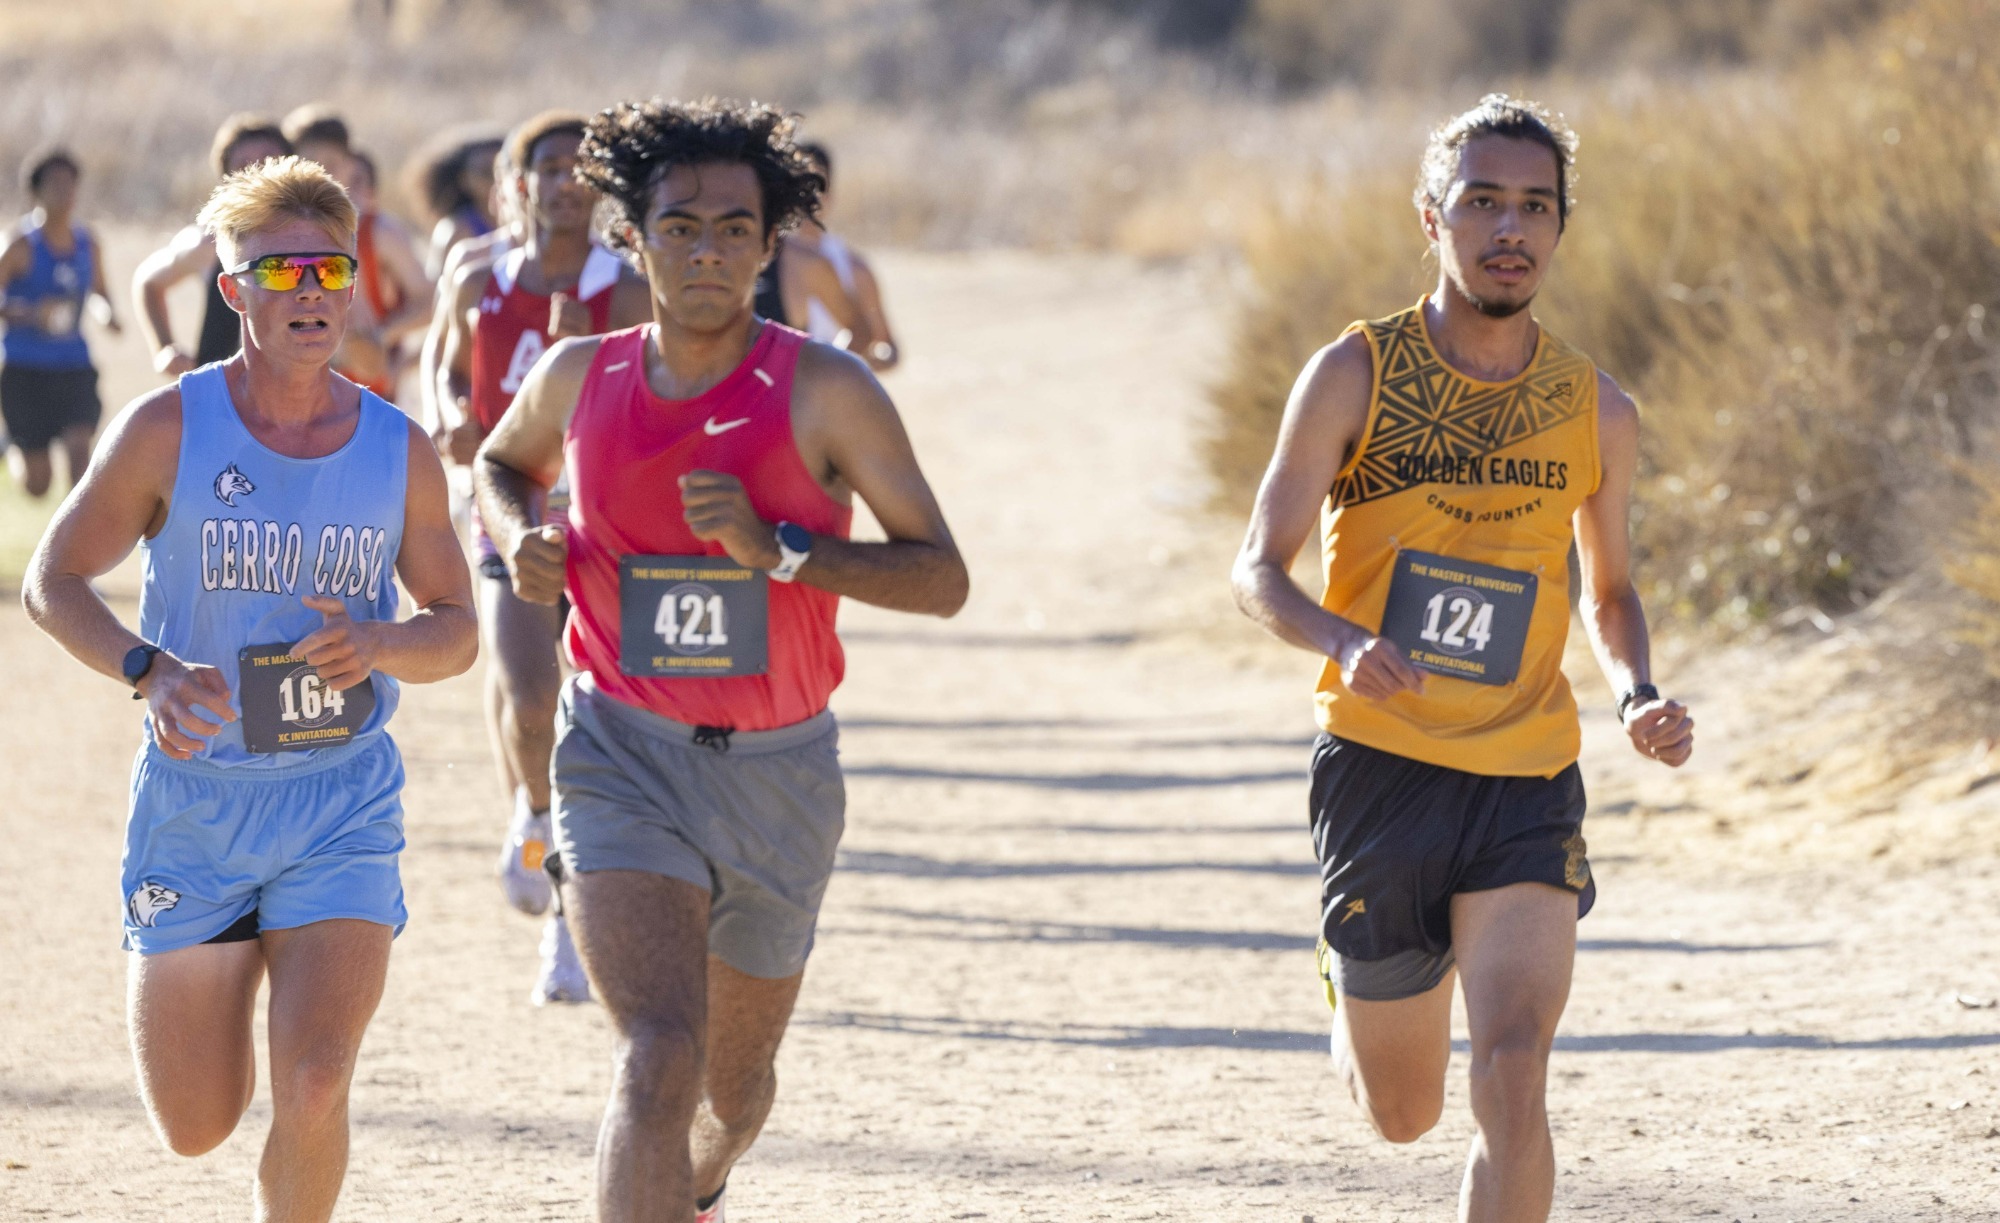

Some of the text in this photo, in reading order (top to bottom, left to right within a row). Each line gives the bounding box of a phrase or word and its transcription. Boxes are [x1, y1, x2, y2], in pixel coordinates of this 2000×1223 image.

[1398, 454, 1568, 490] GOLDEN EAGLES
[1426, 494, 1542, 523] CROSS OUNTRY
[201, 518, 303, 595] CERRO
[631, 567, 753, 581] THE MASTER'S UNIVERSITY
[1410, 562, 1525, 594] THE MASTER'S UNIVERSITY
[654, 594, 728, 645] 421
[1420, 593, 1494, 651] 124
[253, 656, 270, 667] THE
[1409, 649, 1422, 662] XC
[1424, 652, 1485, 674] INVITATIONAL
[280, 675, 345, 721] 164
[278, 733, 290, 743] XC
[291, 727, 350, 741] INVITATIONAL
